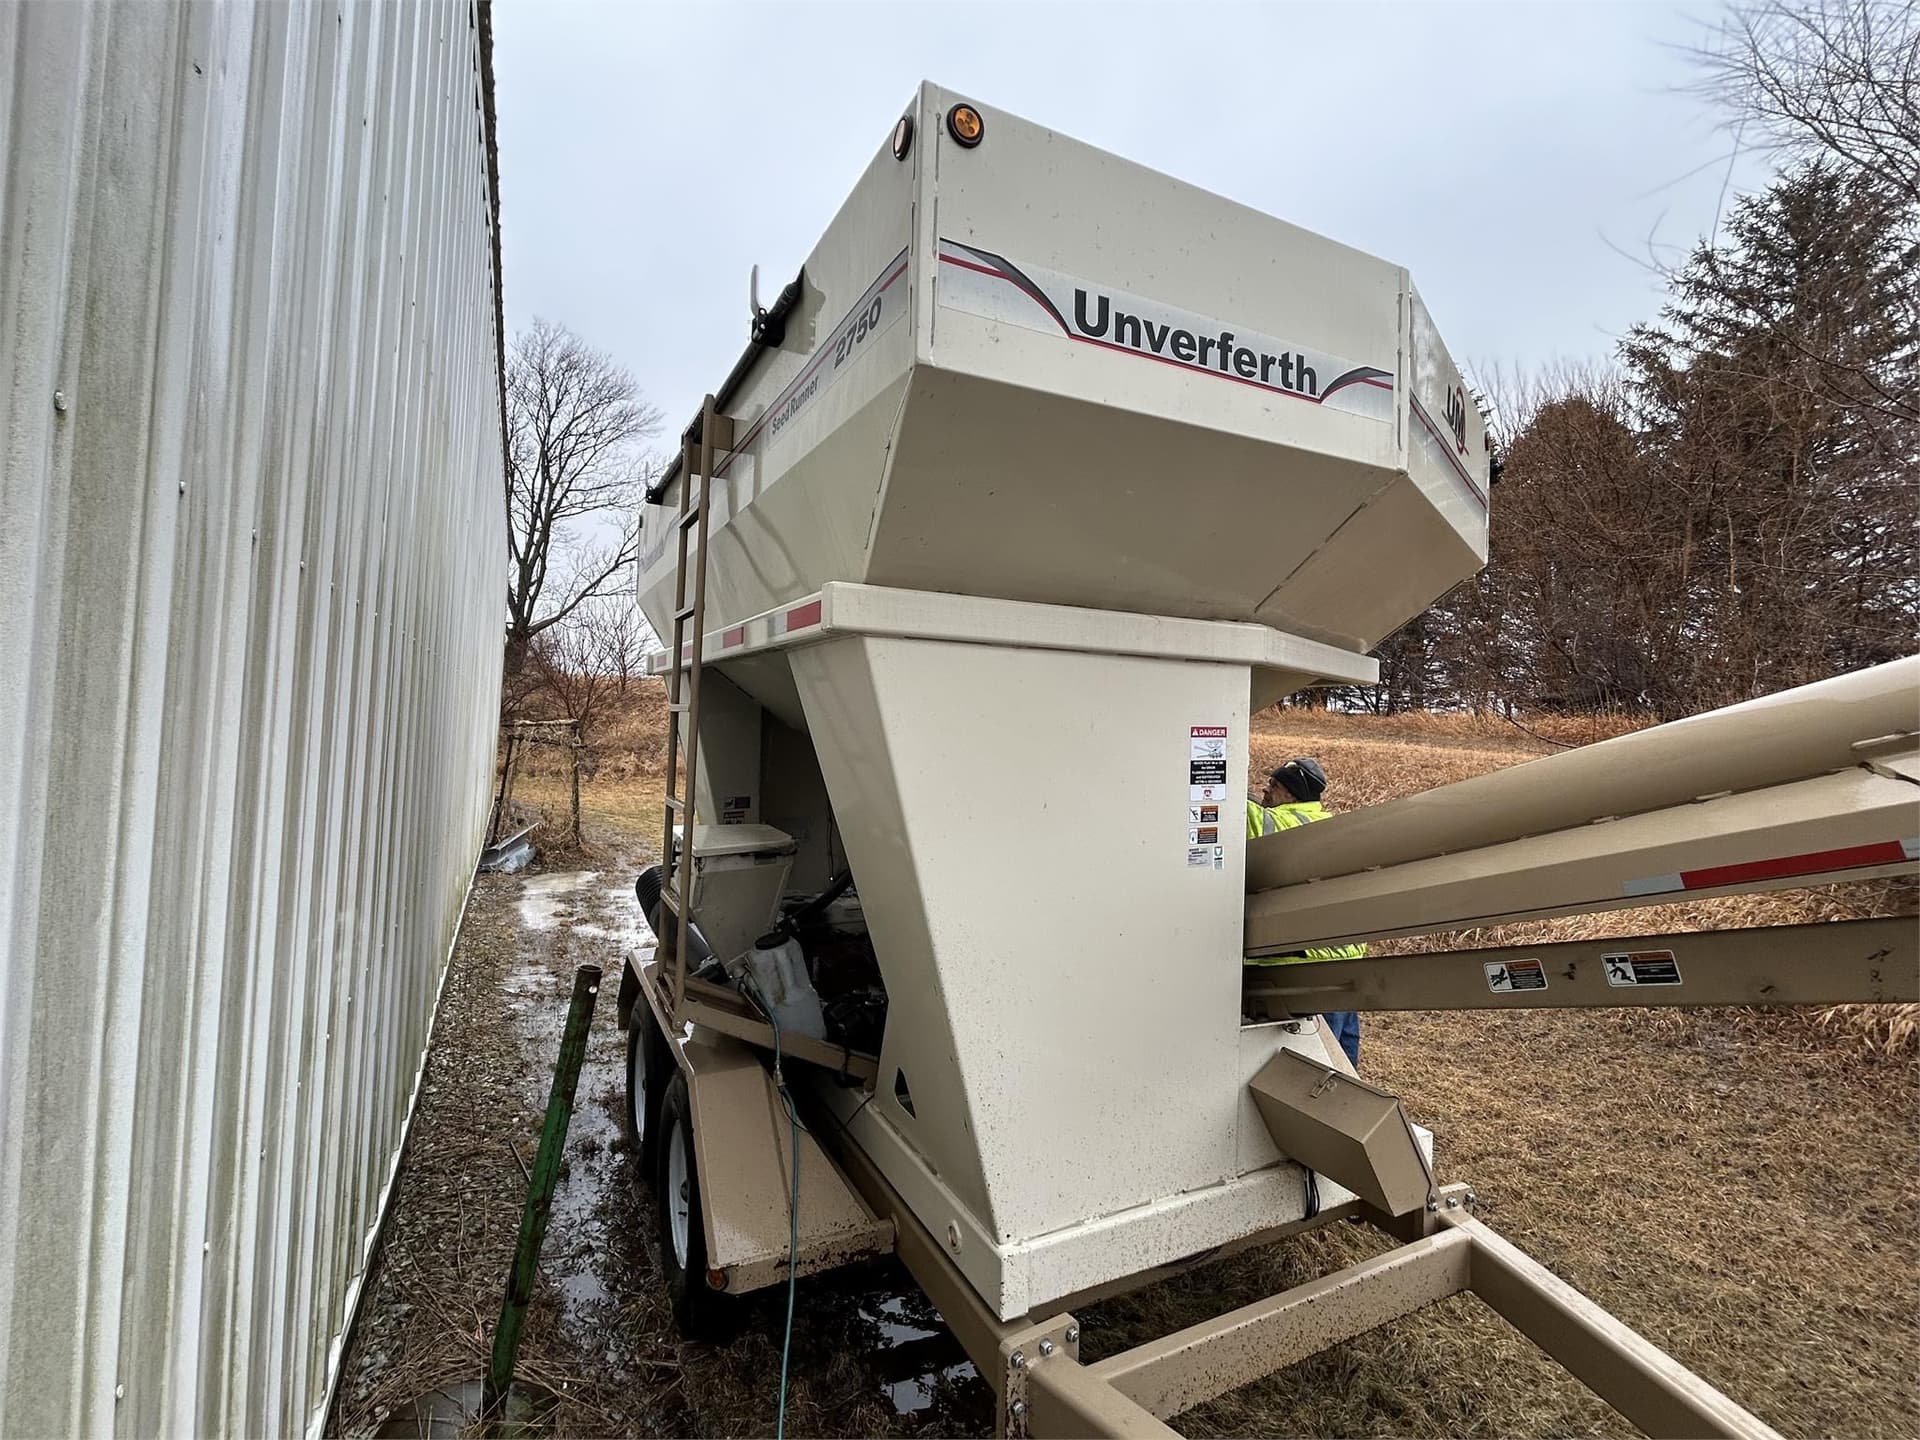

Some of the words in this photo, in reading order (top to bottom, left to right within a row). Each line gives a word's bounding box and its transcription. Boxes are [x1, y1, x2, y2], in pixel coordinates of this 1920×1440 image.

[834, 297, 882, 369] 2750
[1073, 288, 1318, 396] Unverferth
[1199, 728, 1226, 736] DANGER
